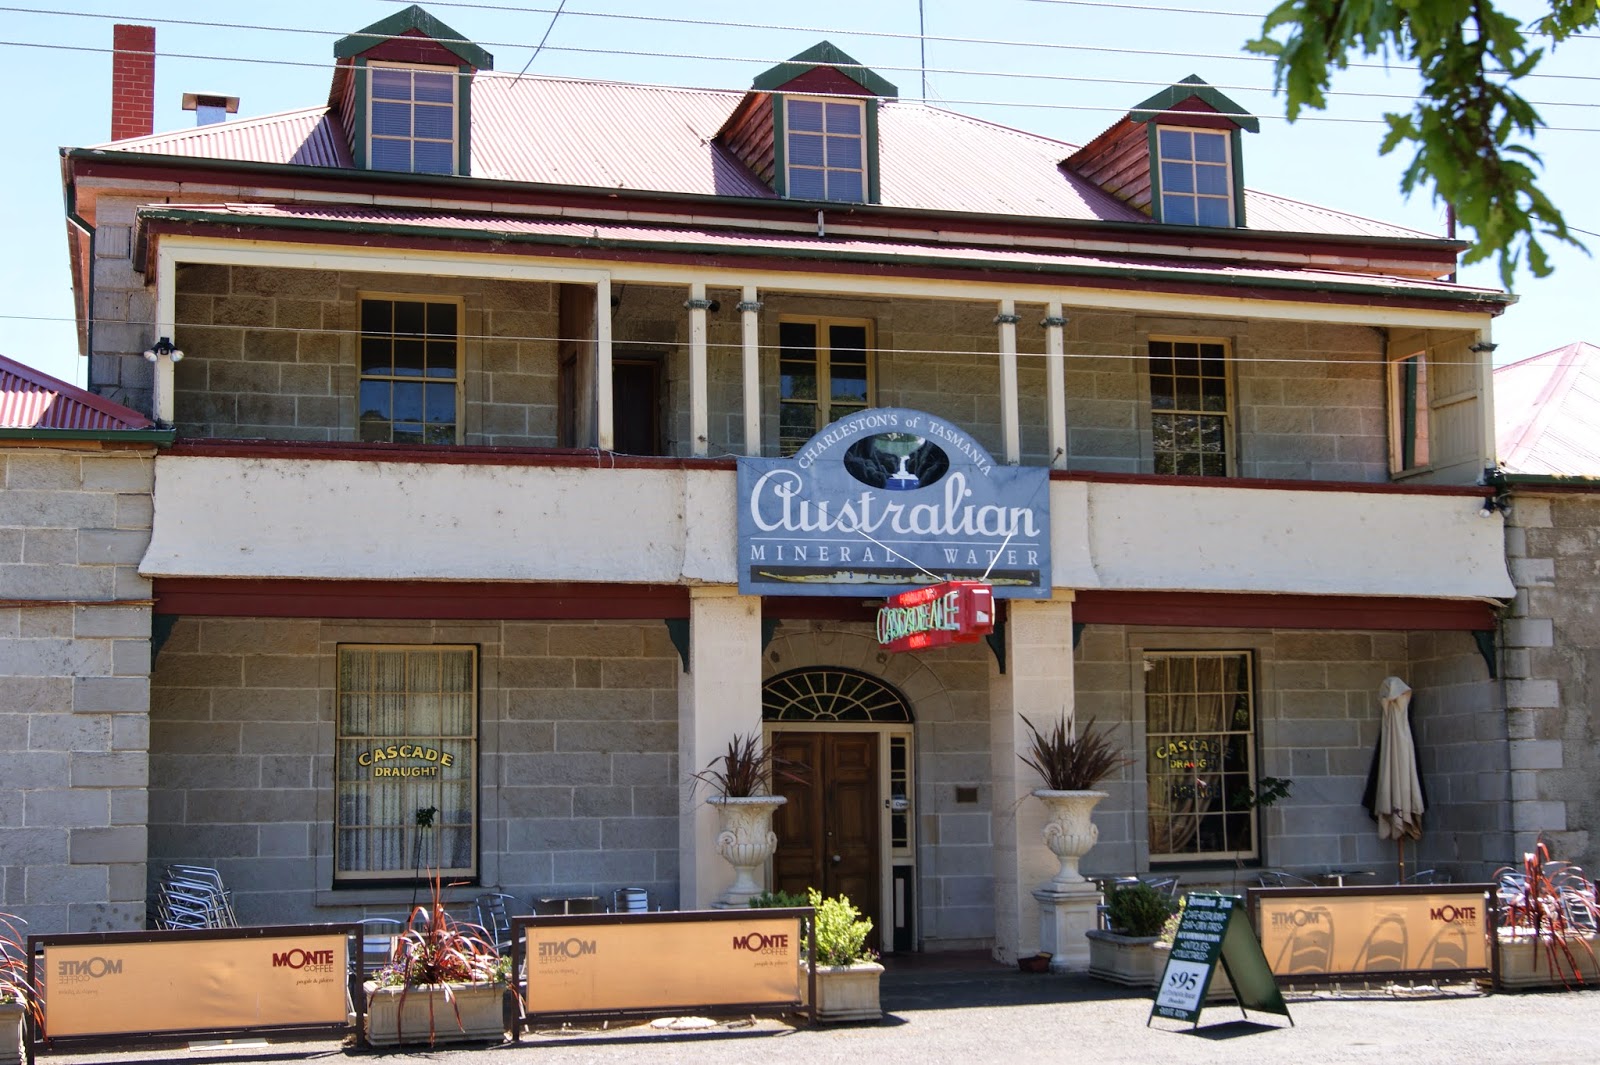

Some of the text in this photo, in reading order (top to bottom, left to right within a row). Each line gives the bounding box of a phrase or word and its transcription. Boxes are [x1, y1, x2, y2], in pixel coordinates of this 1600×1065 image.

[798, 414, 993, 477] CHARLESTON'S of TASMANIA
[751, 469, 1041, 538] Australian
[750, 545, 1039, 566] MINERAL WATER
[358, 745, 454, 767] CASCADE
[374, 766, 438, 777] DRAUGHT
[1430, 905, 1476, 923] MONTE
[733, 932, 788, 952] MONTE
[272, 948, 333, 969] MONTE
[1169, 971, 1199, 990] $95
